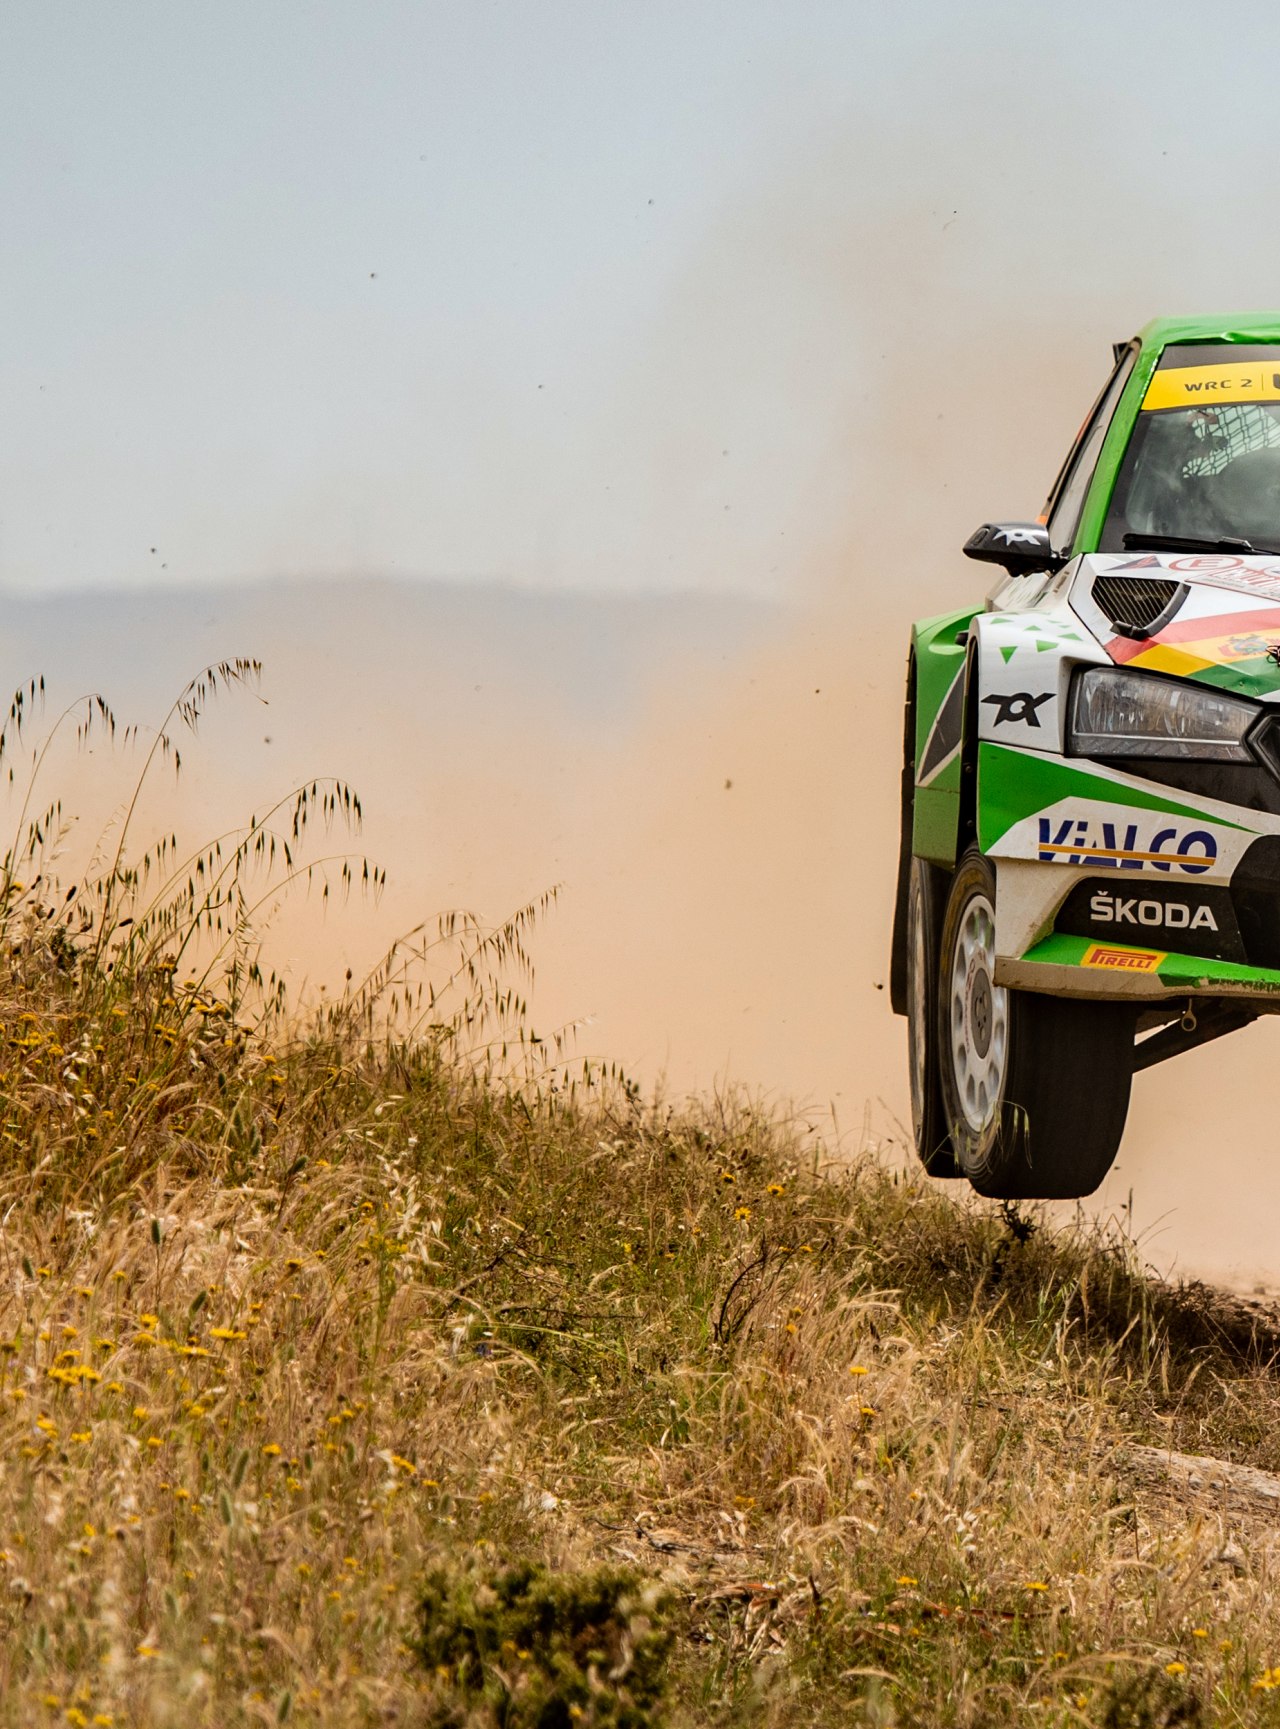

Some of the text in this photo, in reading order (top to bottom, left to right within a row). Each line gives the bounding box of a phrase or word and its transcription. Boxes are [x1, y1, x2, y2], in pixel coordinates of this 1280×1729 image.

[1185, 378, 1253, 392] WRC 2
[1090, 890, 1219, 932] ŠKODA
[1089, 948, 1158, 969] PIRELLI
